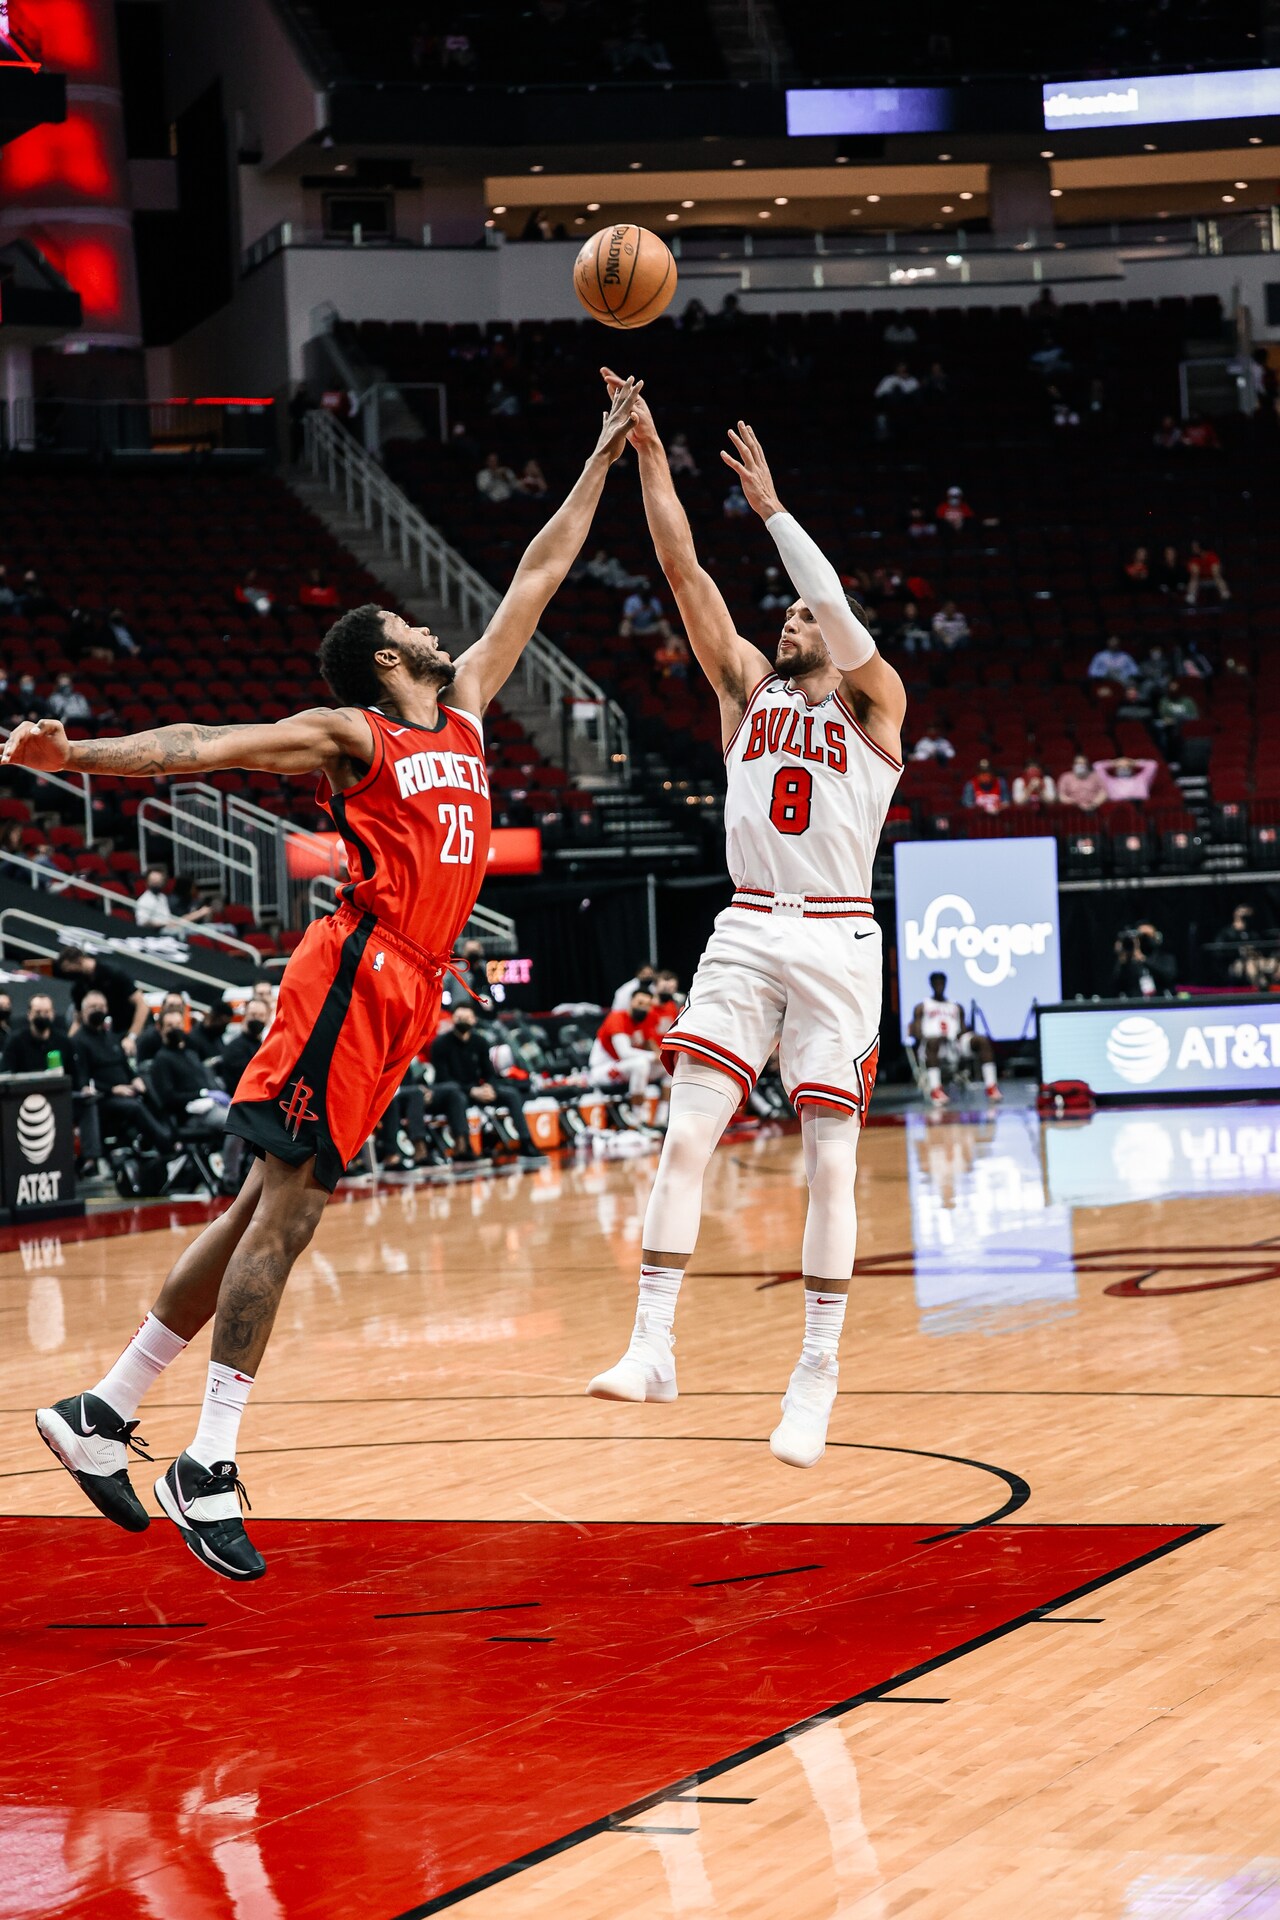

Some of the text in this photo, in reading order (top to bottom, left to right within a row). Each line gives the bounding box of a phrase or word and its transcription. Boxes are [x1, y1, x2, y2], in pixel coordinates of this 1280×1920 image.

[742, 708, 847, 774] BULLS
[394, 751, 489, 800] ROCKETS
[769, 766, 812, 835] 8
[438, 803, 474, 864] 26
[905, 894, 1052, 987] Kroger
[1176, 1023, 1280, 1069] AT&T
[16, 1171, 62, 1205] AT&T
